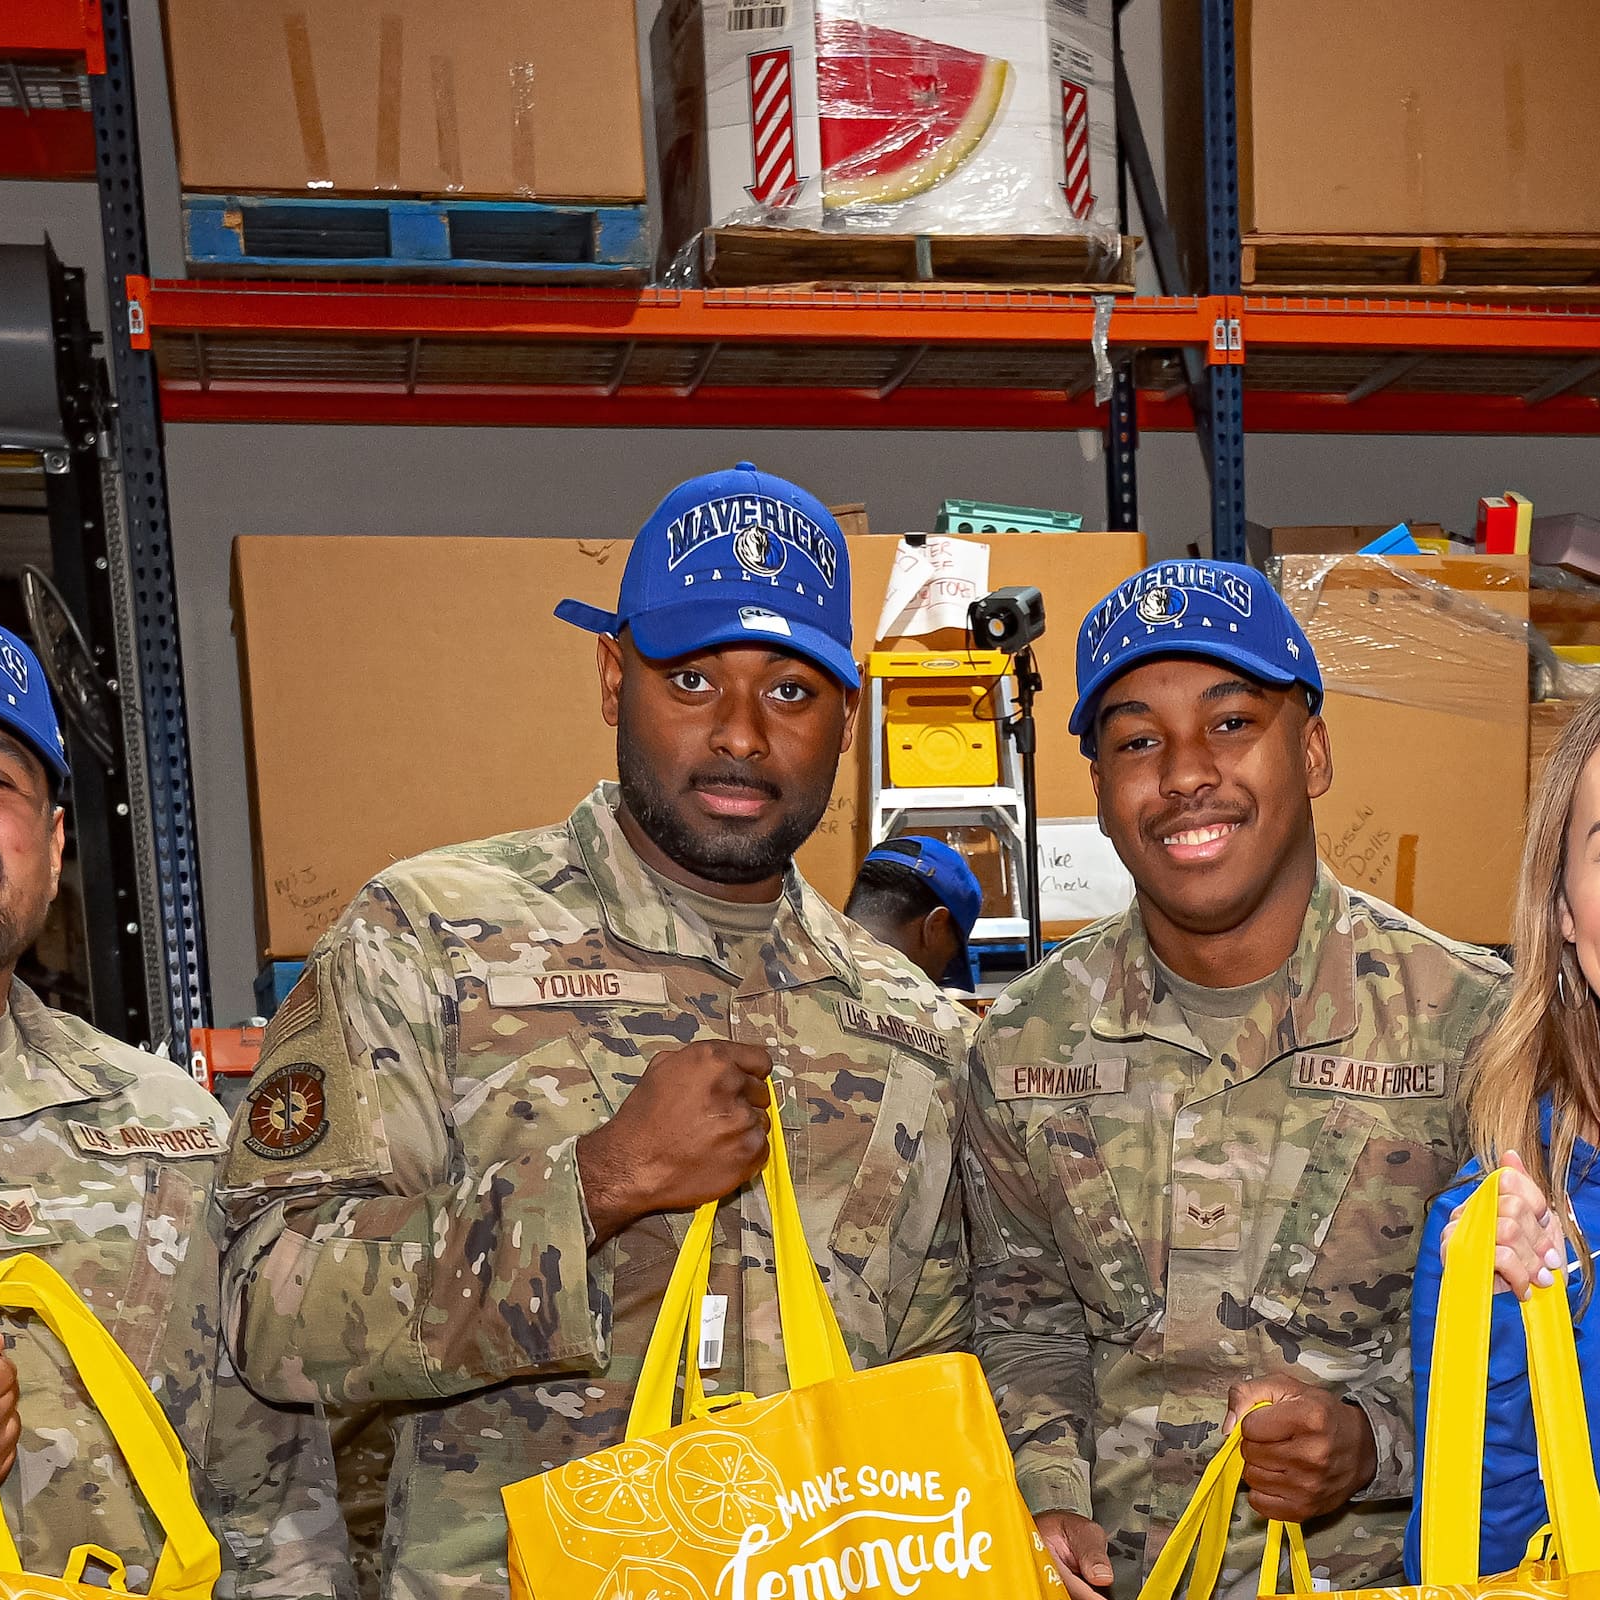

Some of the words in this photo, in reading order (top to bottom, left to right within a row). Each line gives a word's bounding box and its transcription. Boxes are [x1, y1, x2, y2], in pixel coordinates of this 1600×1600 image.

[666, 493, 837, 590] MAVERICKS
[684, 568, 824, 606] DALLAS
[1086, 563, 1252, 662] MAVERICKS
[1102, 615, 1238, 665] DALLAS
[532, 972, 621, 999] YOUNG
[902, 1024, 951, 1060] FORCE
[1013, 1063, 1102, 1094] EMMANUEL
[1298, 1058, 1338, 1087] U.S.
[1341, 1062, 1380, 1091] AIR
[1383, 1064, 1435, 1092] FORCE
[80, 1126, 115, 1150] U.S.
[122, 1129, 153, 1150] AIR
[151, 1131, 217, 1151] FORCE
[775, 1466, 855, 1528] MAKE
[856, 1464, 944, 1502] SOME
